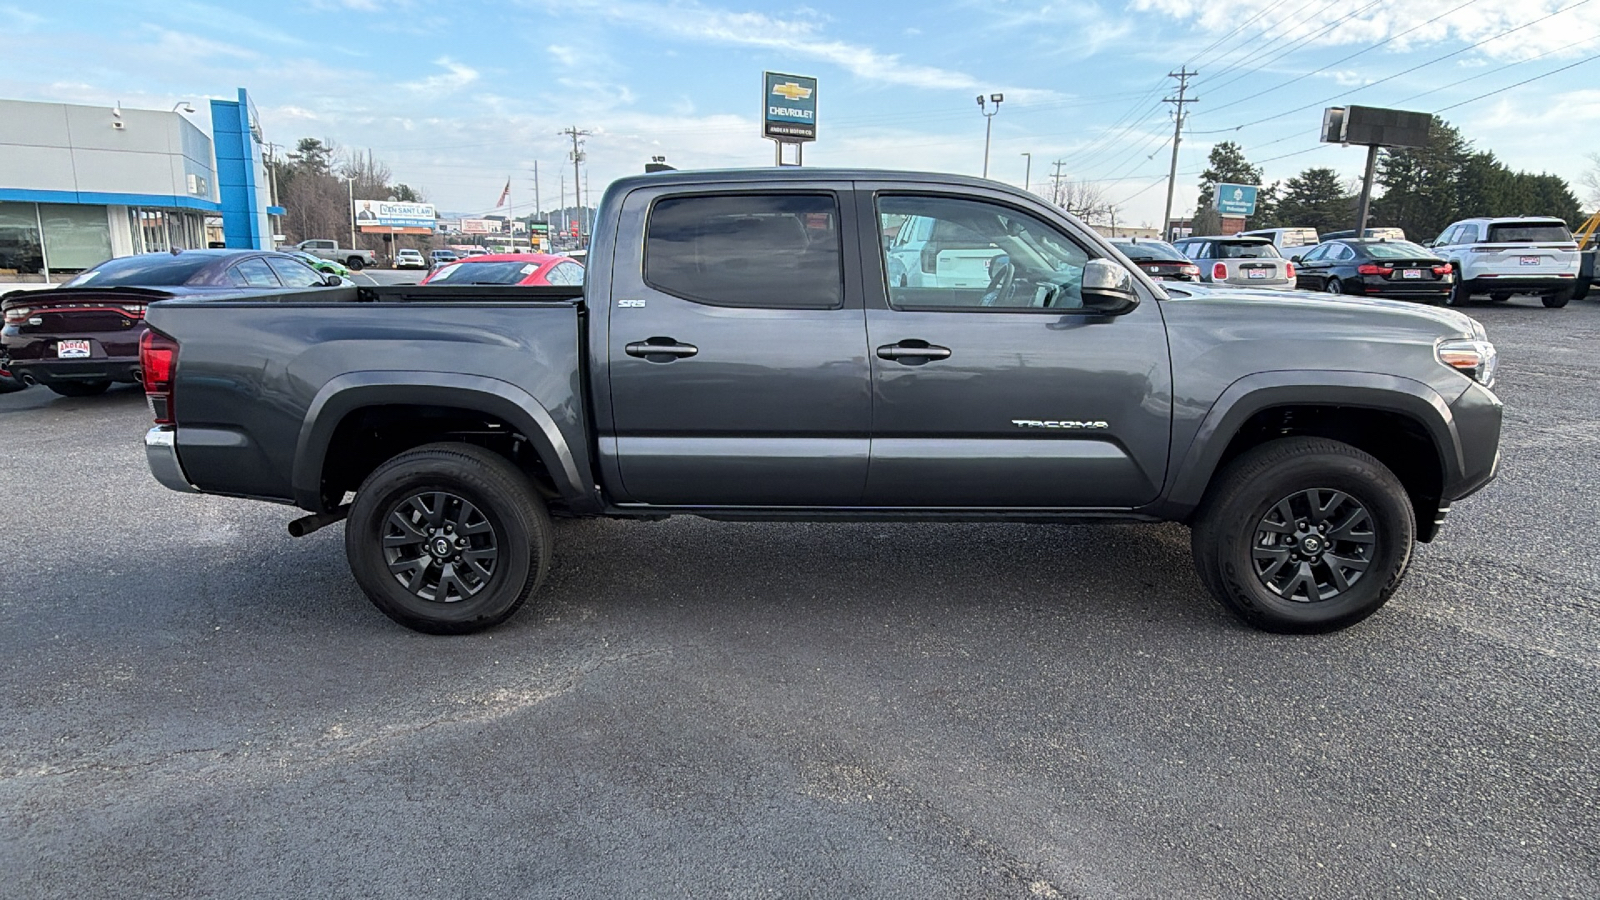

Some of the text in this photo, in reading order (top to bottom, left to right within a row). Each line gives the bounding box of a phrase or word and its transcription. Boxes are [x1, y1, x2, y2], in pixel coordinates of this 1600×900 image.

[769, 106, 813, 118] CHEVROLET
[60, 342, 89, 351] ANDEAN
[1011, 419, 1109, 429] TACOMA
